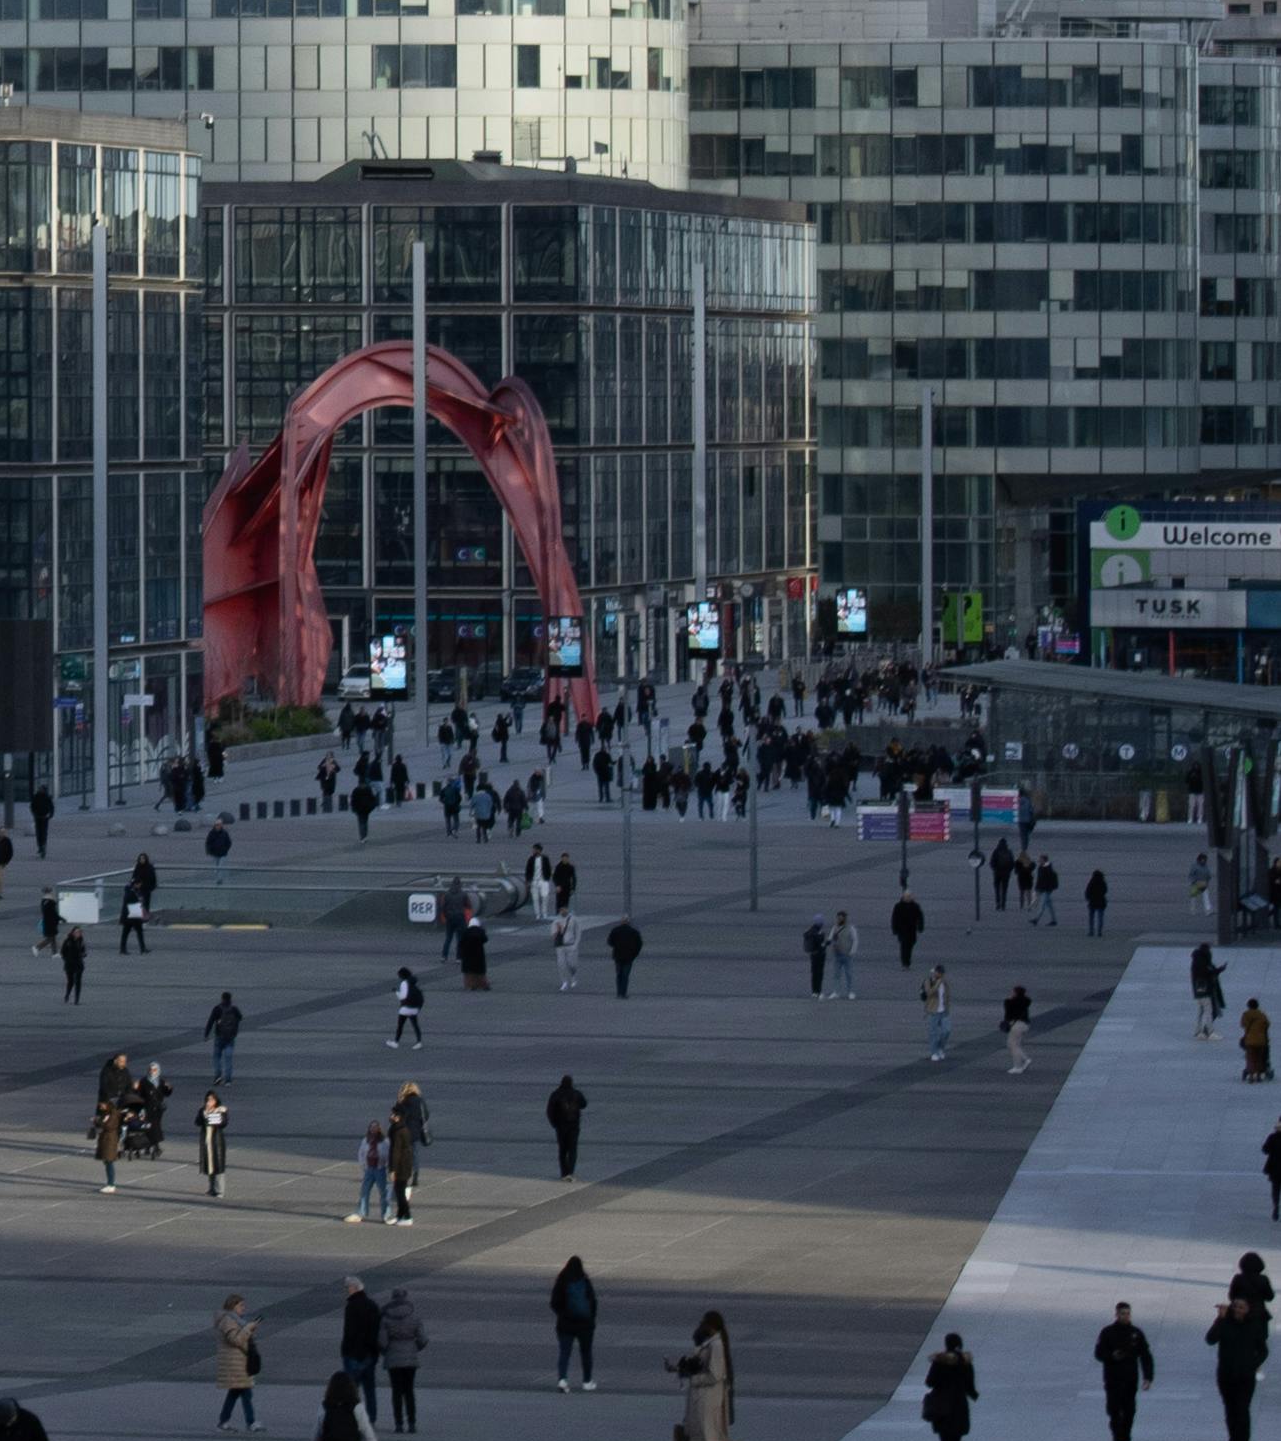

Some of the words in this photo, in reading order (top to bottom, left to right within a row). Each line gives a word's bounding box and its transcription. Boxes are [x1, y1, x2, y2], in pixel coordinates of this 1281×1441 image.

[1163, 525, 1272, 546] Welcome
[457, 547, 486, 562] CC
[1136, 599, 1201, 614] TUSK
[457, 624, 486, 638] CC
[410, 901, 434, 915] RER
